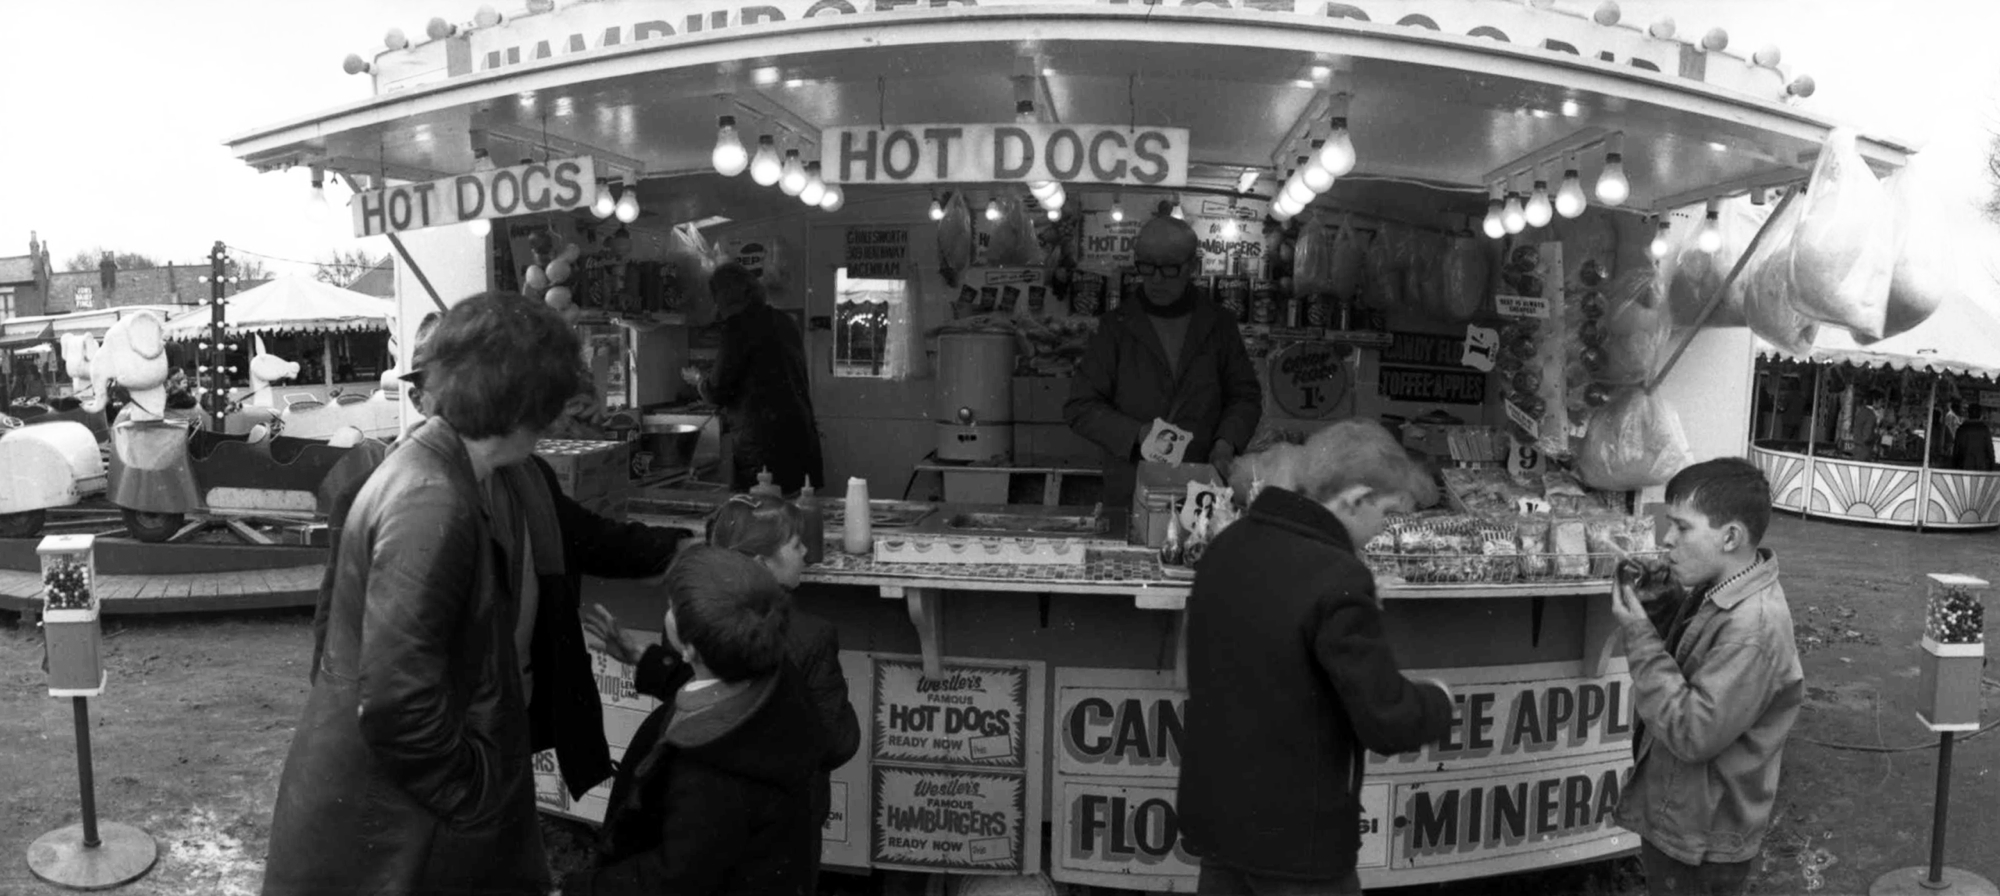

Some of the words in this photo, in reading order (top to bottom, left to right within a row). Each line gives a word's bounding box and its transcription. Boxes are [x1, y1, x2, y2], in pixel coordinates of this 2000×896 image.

[840, 127, 963, 181] HOT
[993, 127, 1171, 184] DOGS
[361, 183, 435, 236] HOT
[455, 162, 582, 221] DOGS
[1088, 235, 1118, 252] HOT
[928, 694, 974, 705] FAMOUS
[890, 704, 941, 732] HOT
[945, 706, 1010, 737] DOGS
[1504, 681, 1633, 755] APPL
[888, 735, 928, 749] READY
[933, 739, 963, 751] NOW
[914, 779, 986, 799] Westler's
[927, 798, 974, 810] FAMOUS
[888, 805, 1007, 836] HAMBURGERS
[1406, 769, 1630, 857] MINERA
[888, 837, 928, 850] READY
[933, 841, 963, 852] NOW
[1072, 794, 1196, 865] FLO
